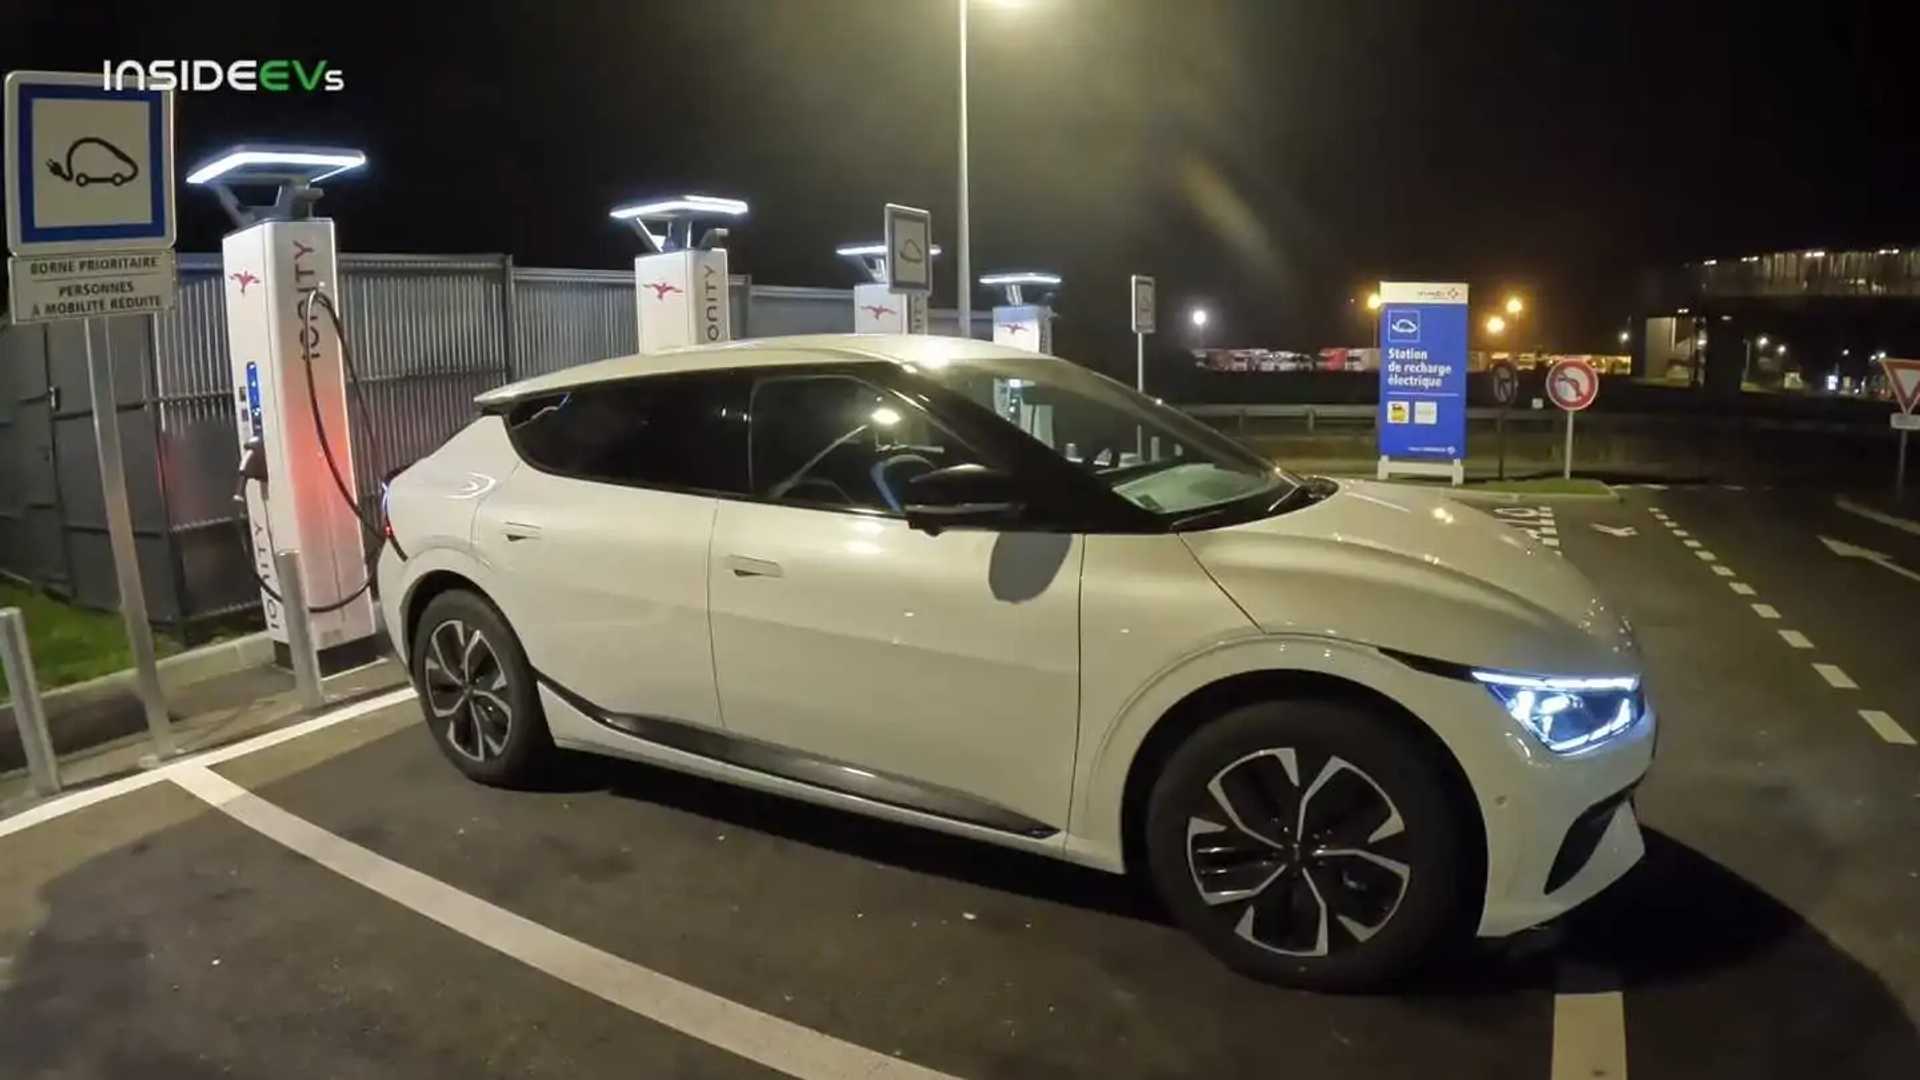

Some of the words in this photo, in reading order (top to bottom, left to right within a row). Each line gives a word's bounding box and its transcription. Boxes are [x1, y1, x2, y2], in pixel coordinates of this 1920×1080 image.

[30, 258, 74, 275] BORNE
[79, 255, 159, 272] PRIORITAIRE
[58, 281, 135, 297] PERSONNES
[704, 264, 720, 341] ONITY
[1388, 347, 1428, 360] Station
[1388, 360, 1402, 373] de
[1404, 361, 1452, 377] recharge
